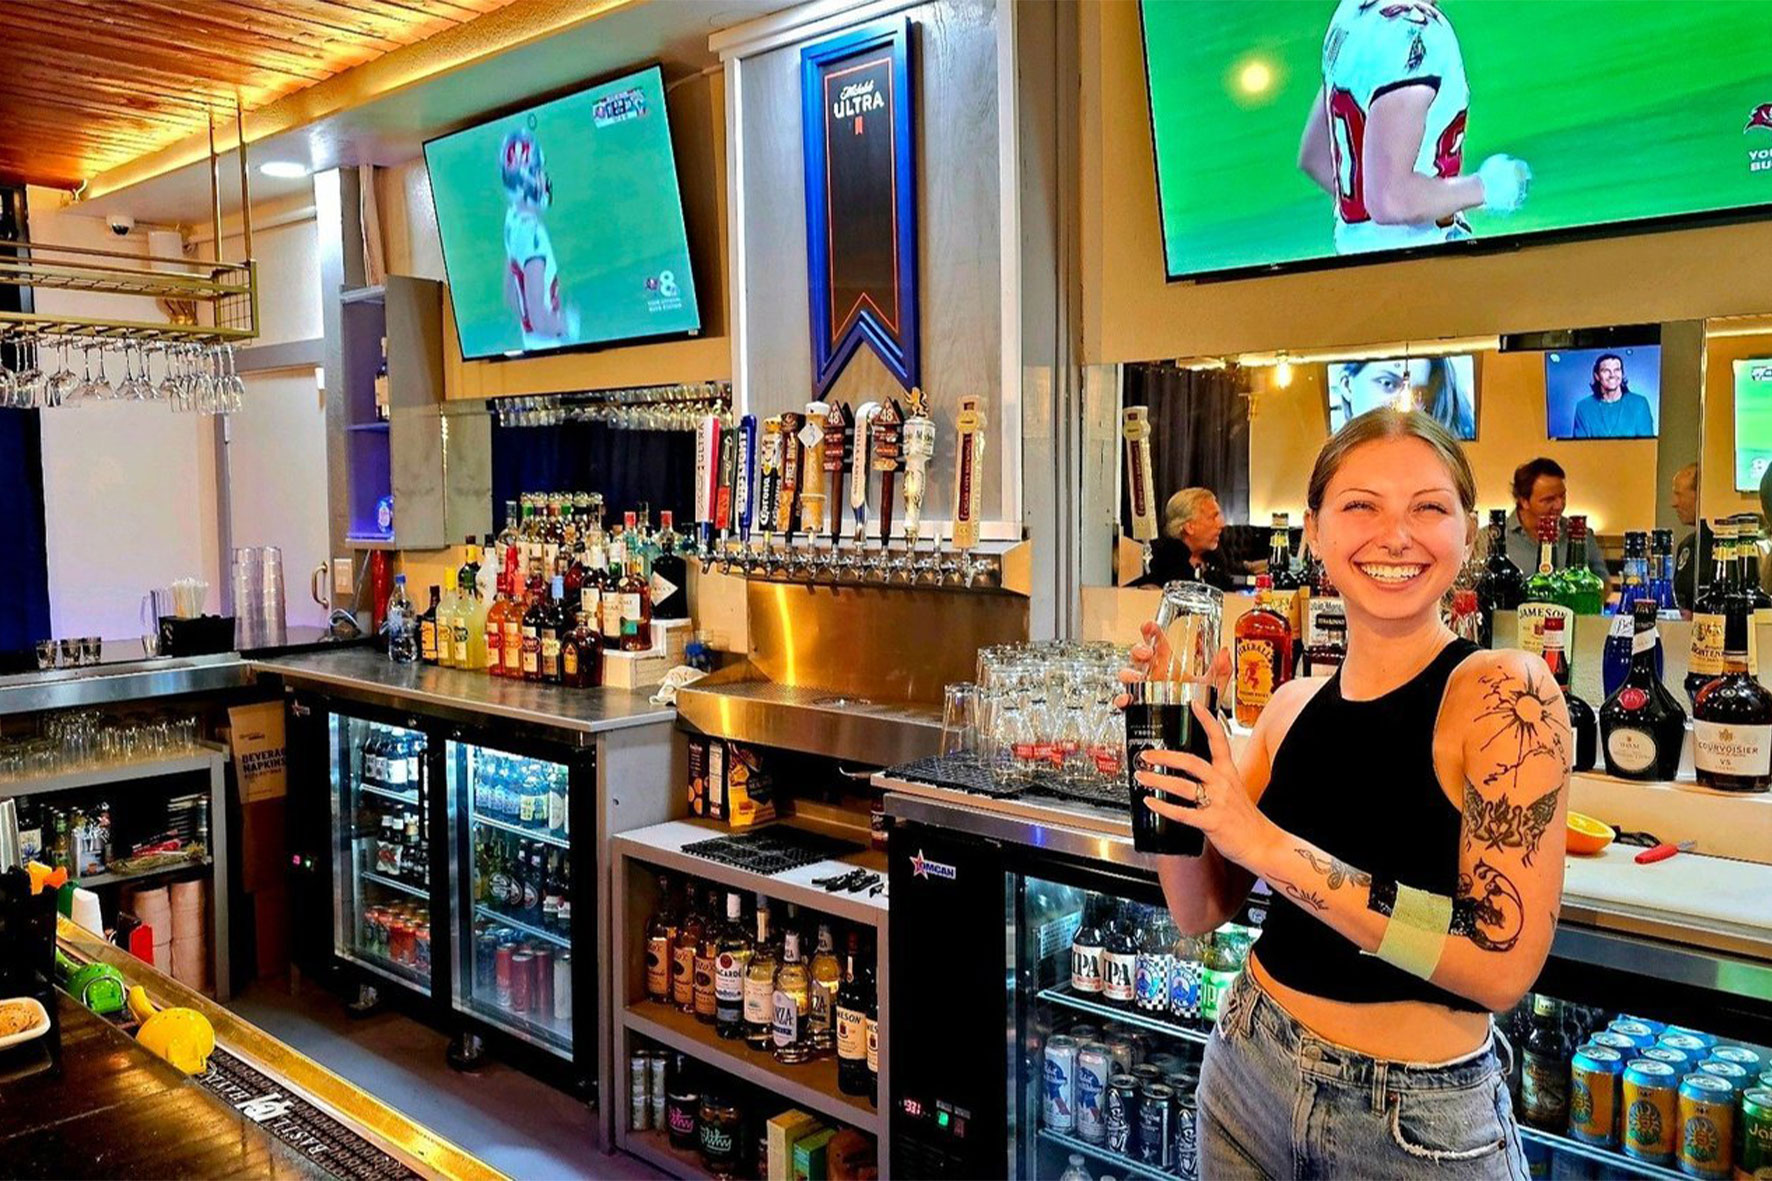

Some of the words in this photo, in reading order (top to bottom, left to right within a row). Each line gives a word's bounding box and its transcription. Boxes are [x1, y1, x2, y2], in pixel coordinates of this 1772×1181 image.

[833, 91, 885, 118] ULTRA
[1750, 160, 1772, 171] BU
[659, 270, 675, 297] 8
[828, 411, 840, 425] 48
[881, 408, 893, 422] 48
[697, 422, 706, 461] ULTRA
[760, 476, 771, 526] Corona
[1519, 607, 1568, 619] JAMESON
[242, 748, 285, 764] BEVERA
[1698, 741, 1759, 755] COURVOISIER
[1072, 951, 1101, 978] IPA
[1103, 958, 1132, 986] IPA
[273, 1117, 330, 1155] BASIL
